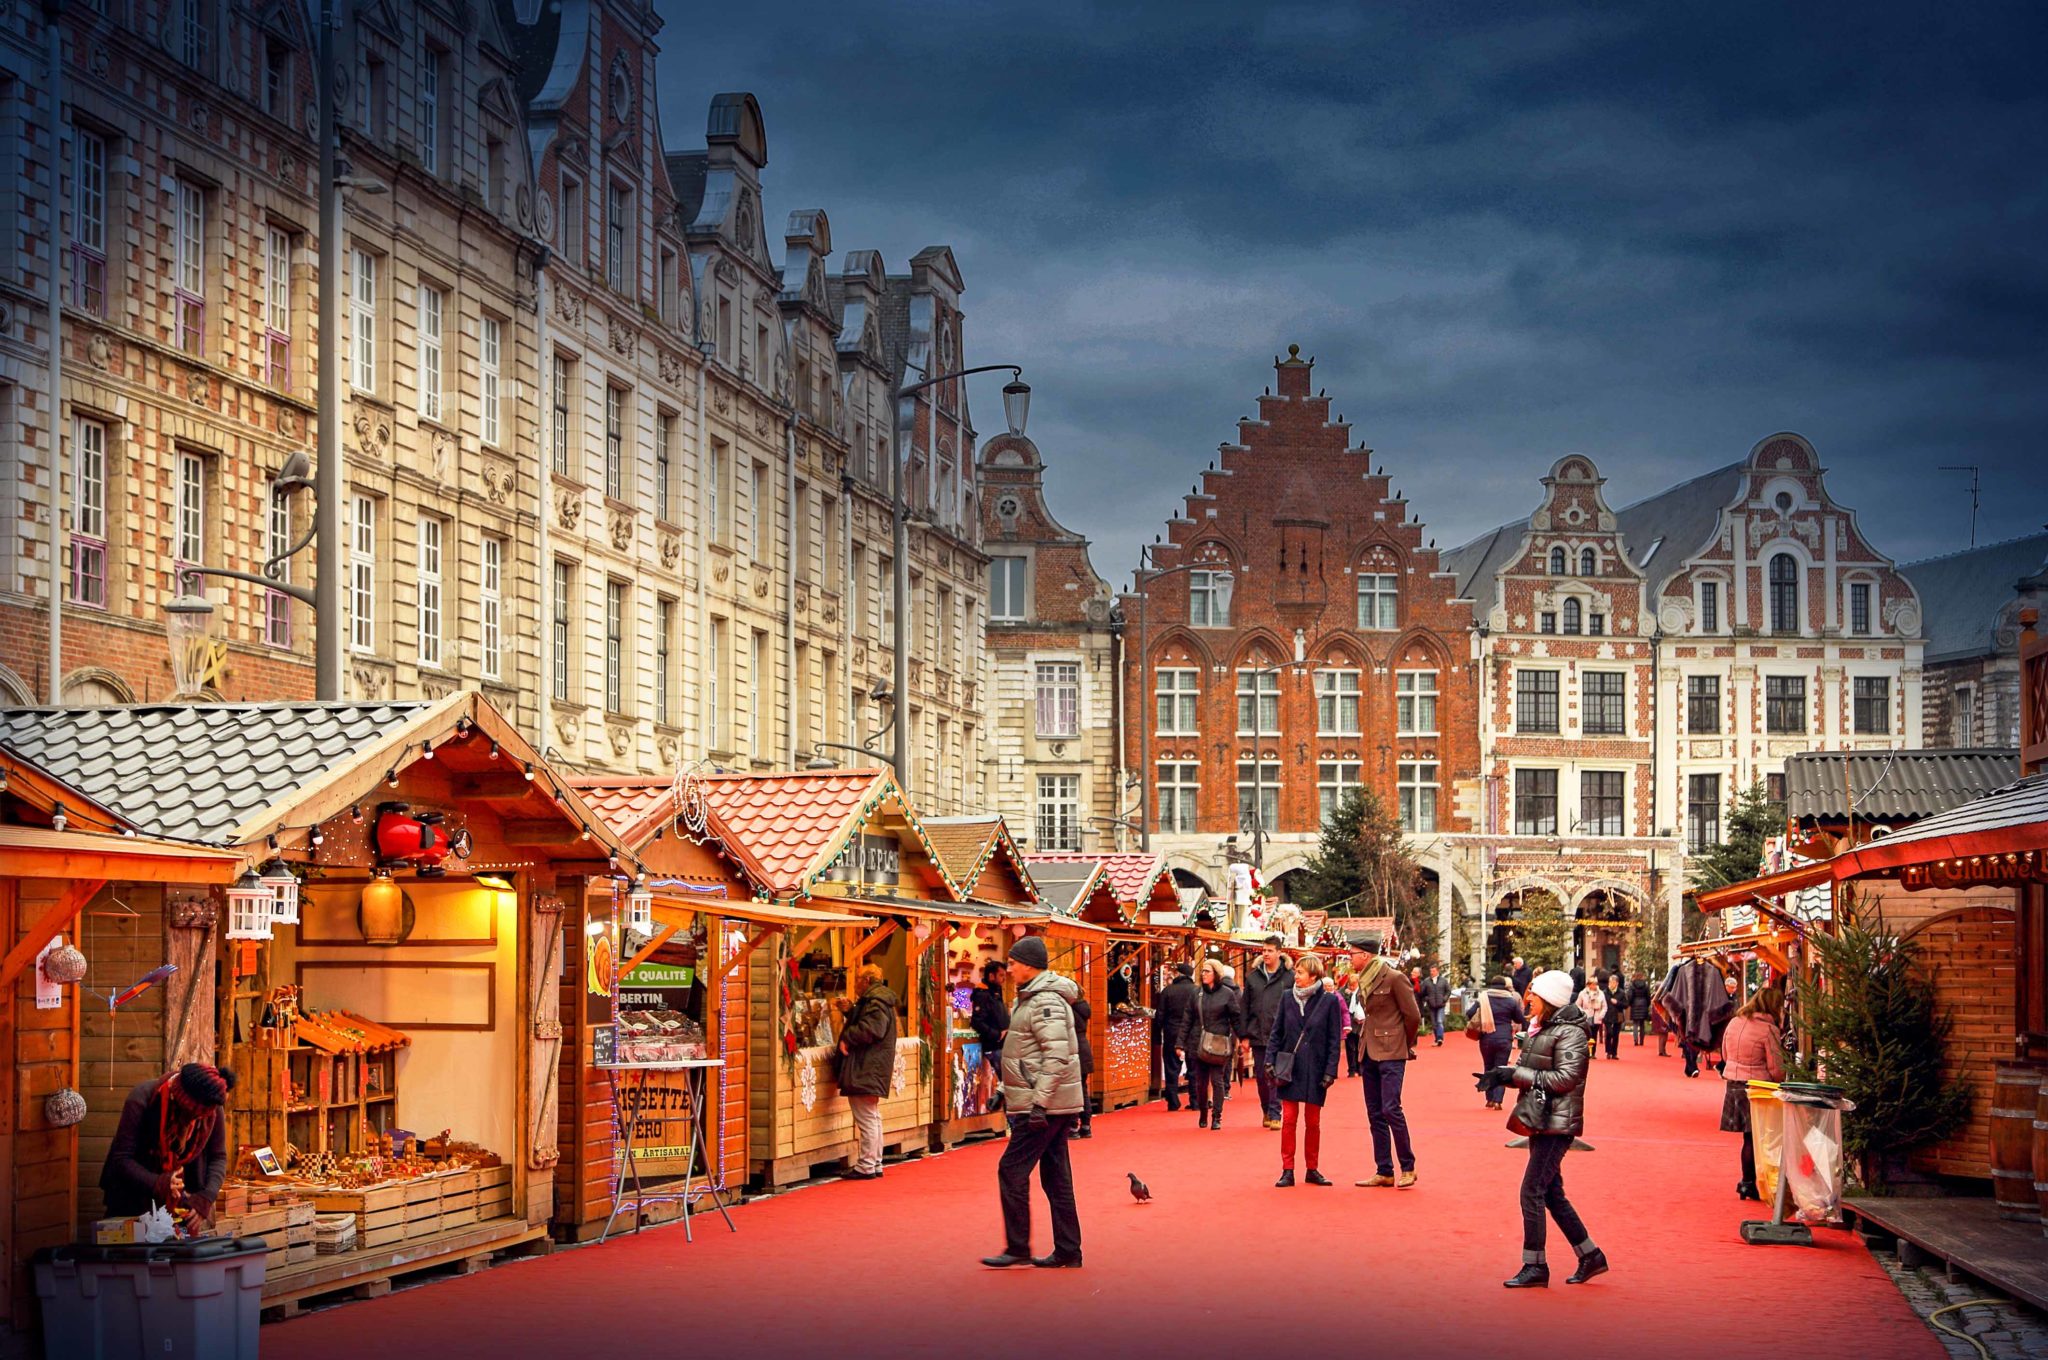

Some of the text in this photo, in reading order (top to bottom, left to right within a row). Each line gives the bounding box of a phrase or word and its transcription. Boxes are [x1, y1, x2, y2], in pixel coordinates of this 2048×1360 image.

[638, 969, 687, 982] QUALITÉ
[619, 993, 663, 1004] BERTIN
[617, 1087, 687, 1111] ISSETTE
